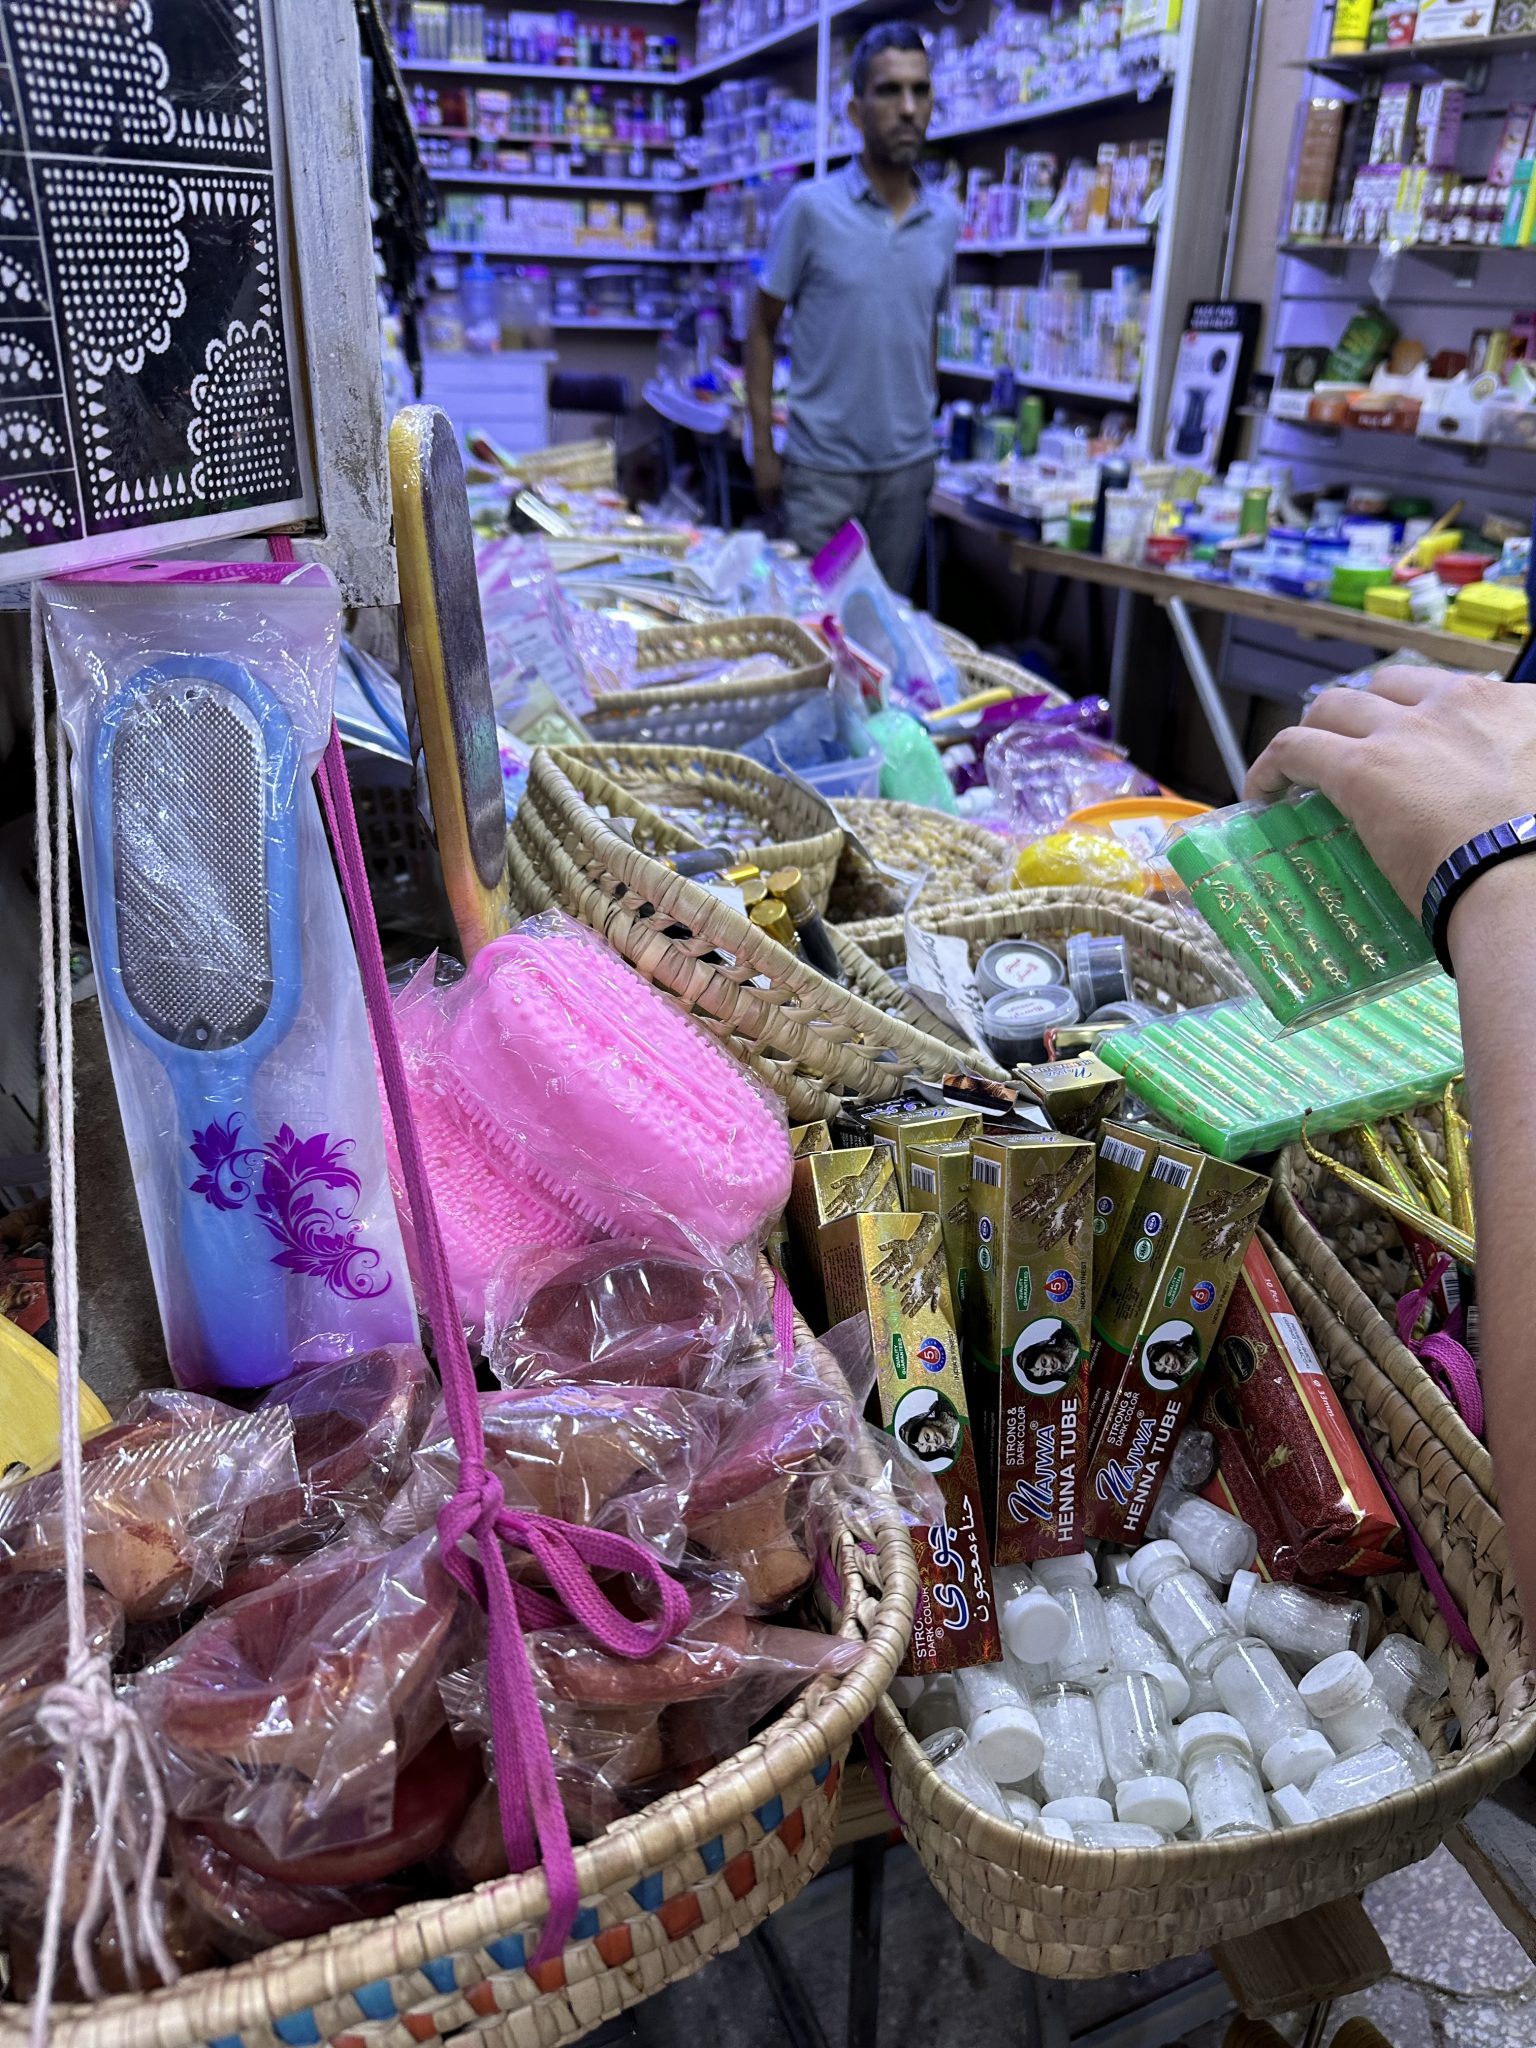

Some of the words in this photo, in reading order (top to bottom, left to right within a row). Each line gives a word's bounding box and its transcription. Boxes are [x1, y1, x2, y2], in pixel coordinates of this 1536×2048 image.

[1050, 1282, 1061, 1291] 5
[1195, 1291, 1204, 1299] 5
[893, 1344, 901, 1369] QUALITY
[924, 1351, 935, 1360] 5
[1007, 1407, 1017, 1415] &
[1017, 1405, 1026, 1437] COLOR
[1060, 1398, 1078, 1460] TUBE
[1107, 1401, 1129, 1444] STRONG
[1115, 1424, 1128, 1446] DARK
[1124, 1392, 1140, 1421] COLOR
[1006, 1420, 1017, 1466] STRONG
[1016, 1441, 1025, 1466] DARK
[1095, 1418, 1156, 1505] NAJWA
[1008, 1424, 1057, 1523] NAJWA
[1123, 1460, 1160, 1531] HENNA
[1150, 1400, 1182, 1456] TUBE
[1057, 1463, 1077, 1542] HENNA
[928, 1524, 970, 1630] جوى
[969, 1543, 991, 1622] معجون
[922, 1586, 932, 1624] COLOR
[913, 1617, 927, 1658] STRO
[924, 1626, 936, 1657] DARK
